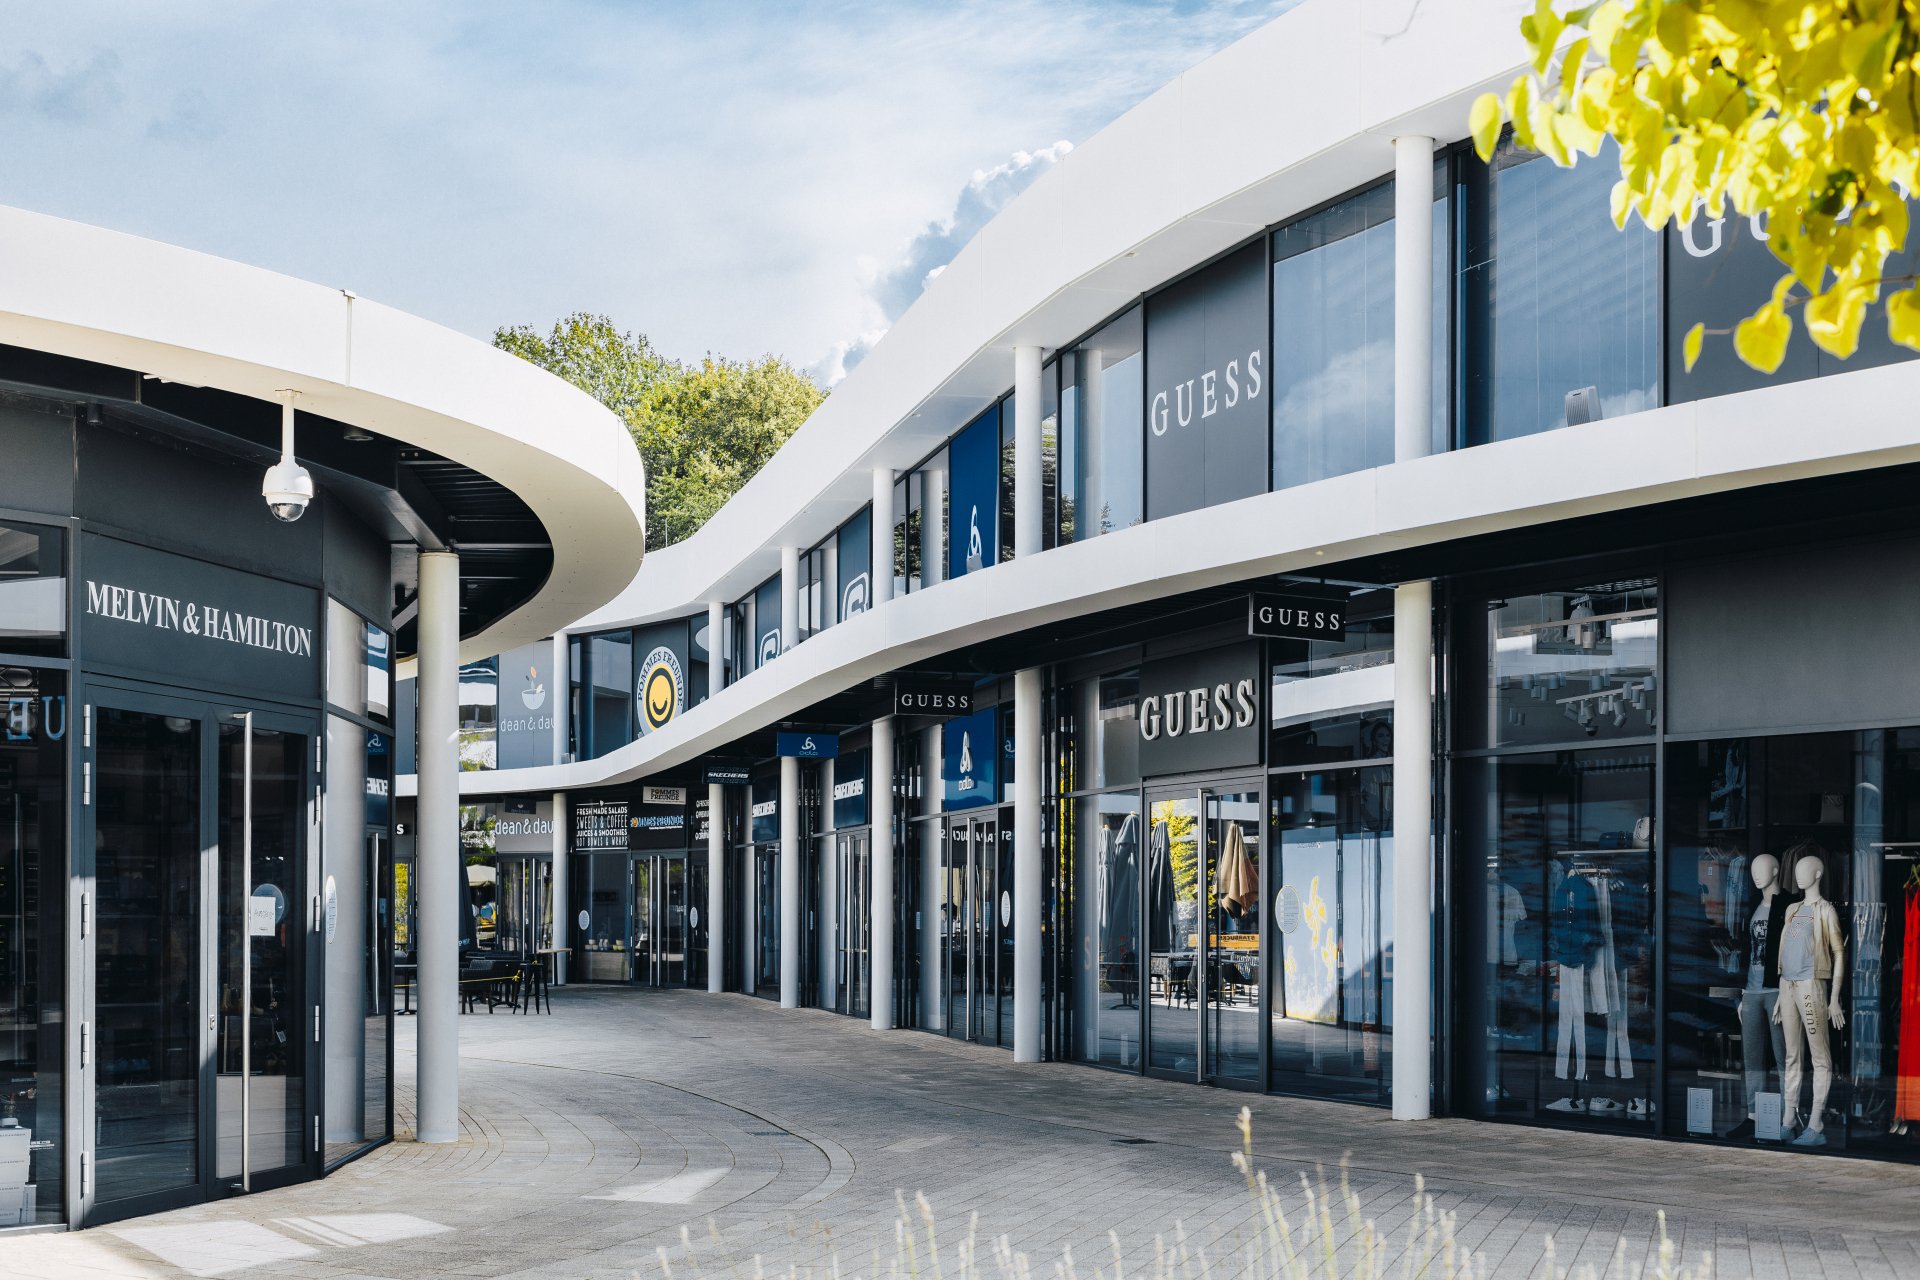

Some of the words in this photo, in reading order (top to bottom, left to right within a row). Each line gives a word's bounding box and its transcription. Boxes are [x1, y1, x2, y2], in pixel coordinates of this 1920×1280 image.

[1150, 349, 1263, 438] GUESS
[1258, 606, 1341, 630] GUESS
[638, 651, 662, 701] POMMES
[663, 650, 683, 707] FREUNDE
[901, 694, 968, 709] GUESS
[1140, 678, 1257, 741] GUESS
[576, 808, 593, 816] FRESH
[593, 807, 608, 815] MADE
[608, 806, 628, 815] SALADS
[607, 814, 628, 829] COFFEE
[576, 829, 593, 838] JUICES
[599, 829, 628, 837] SMOOTHIES
[1804, 994, 1817, 1035] GUESS
